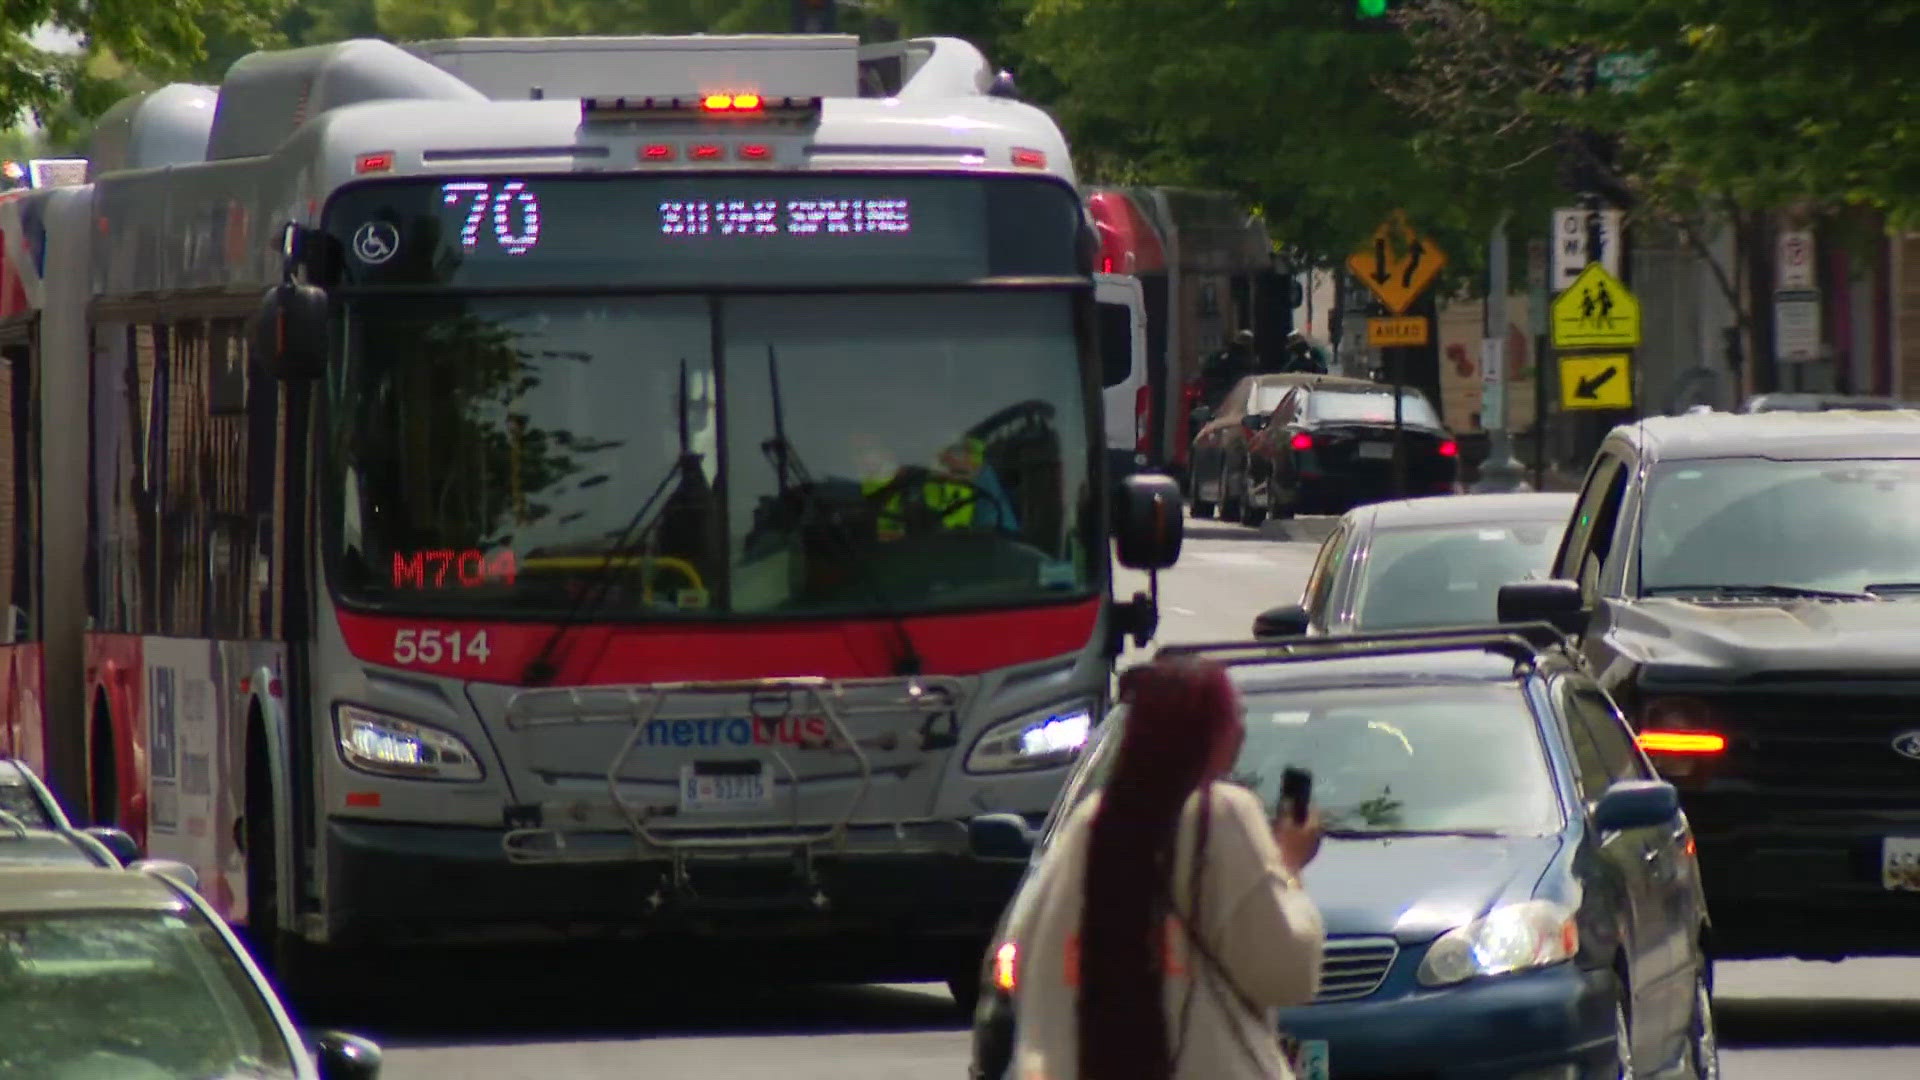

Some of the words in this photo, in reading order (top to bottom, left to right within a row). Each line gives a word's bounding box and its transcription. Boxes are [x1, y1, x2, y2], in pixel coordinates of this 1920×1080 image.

[442, 183, 538, 255] 70
[1376, 325, 1420, 338] AHEAD
[392, 548, 517, 590] M704
[393, 628, 491, 665] 5514
